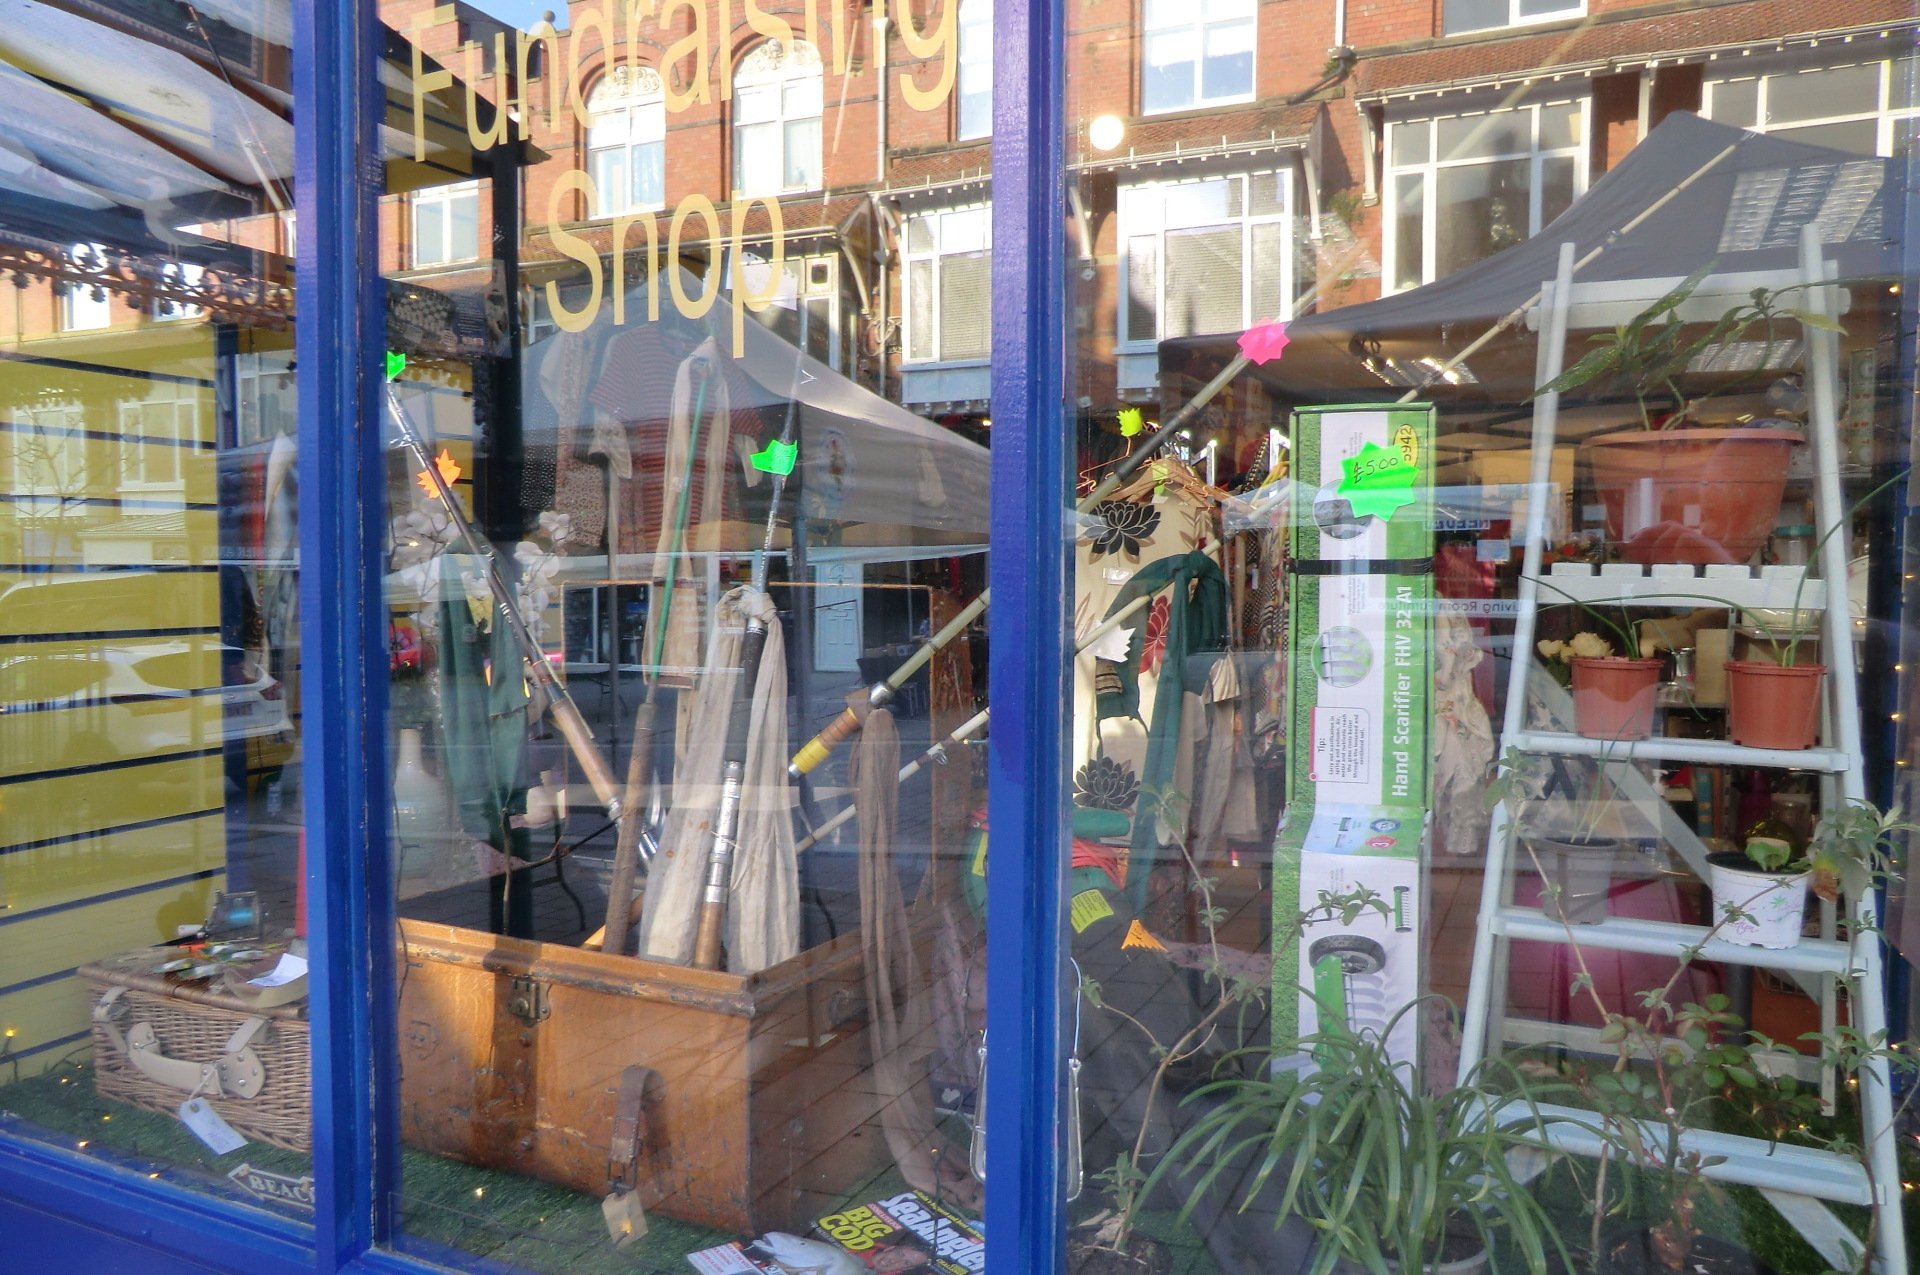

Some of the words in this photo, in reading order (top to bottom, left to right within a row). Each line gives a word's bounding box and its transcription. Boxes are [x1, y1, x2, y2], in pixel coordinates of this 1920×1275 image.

[411, 0, 959, 162] Fundraising
[546, 164, 784, 358] Shop
[1396, 586, 1412, 603] A1
[1396, 610, 1412, 628] 32
[1395, 635, 1411, 666] FHV
[1393, 673, 1410, 744] Scarifier
[1318, 738, 1326, 752] Tip:
[1392, 752, 1408, 796] Hand
[819, 1214, 876, 1250] COD
[842, 1206, 894, 1239] BIG
